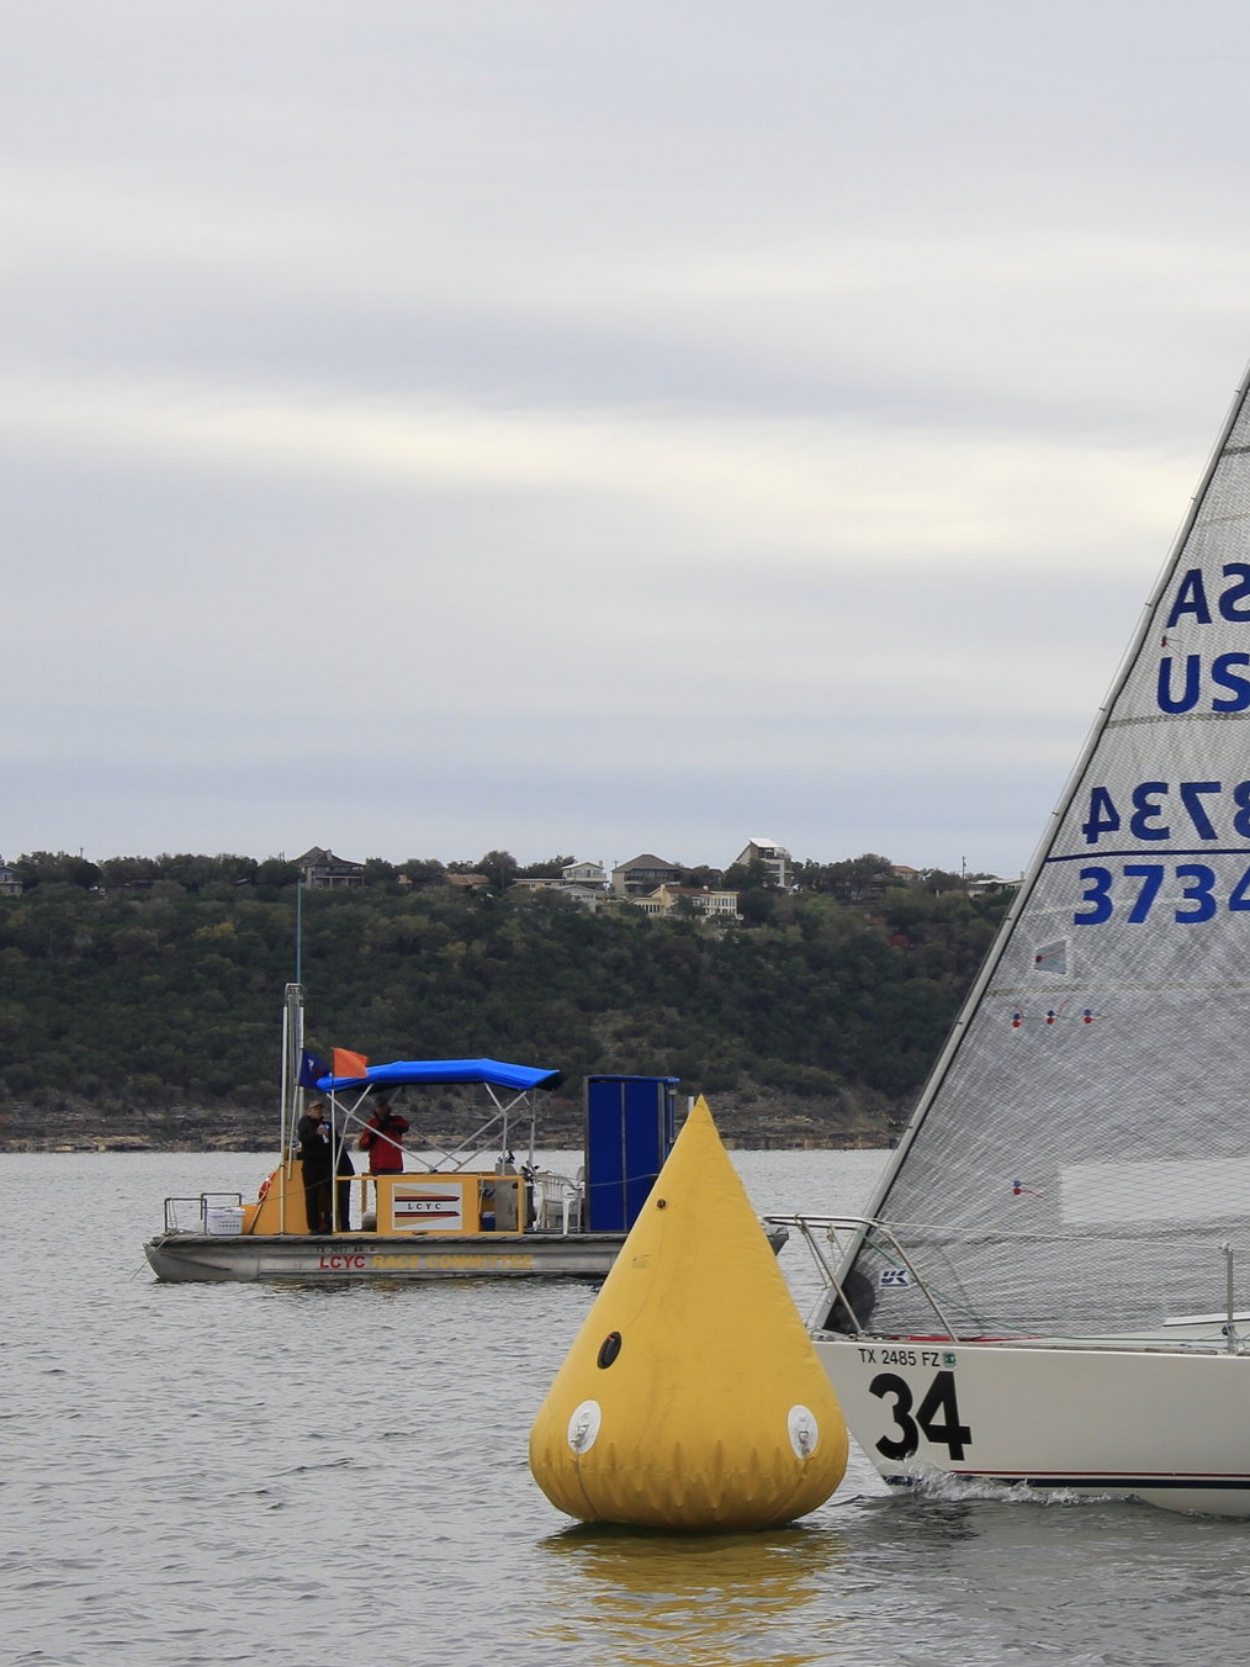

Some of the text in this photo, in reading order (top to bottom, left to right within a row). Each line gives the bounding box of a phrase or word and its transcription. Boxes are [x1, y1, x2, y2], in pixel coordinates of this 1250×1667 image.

[407, 1203, 442, 1211] LCYC
[319, 1254, 534, 1270] LCYC RACE COMMITTEE
[858, 1348, 941, 1367] TX 2485 FZ
[868, 1371, 973, 1461] 34
